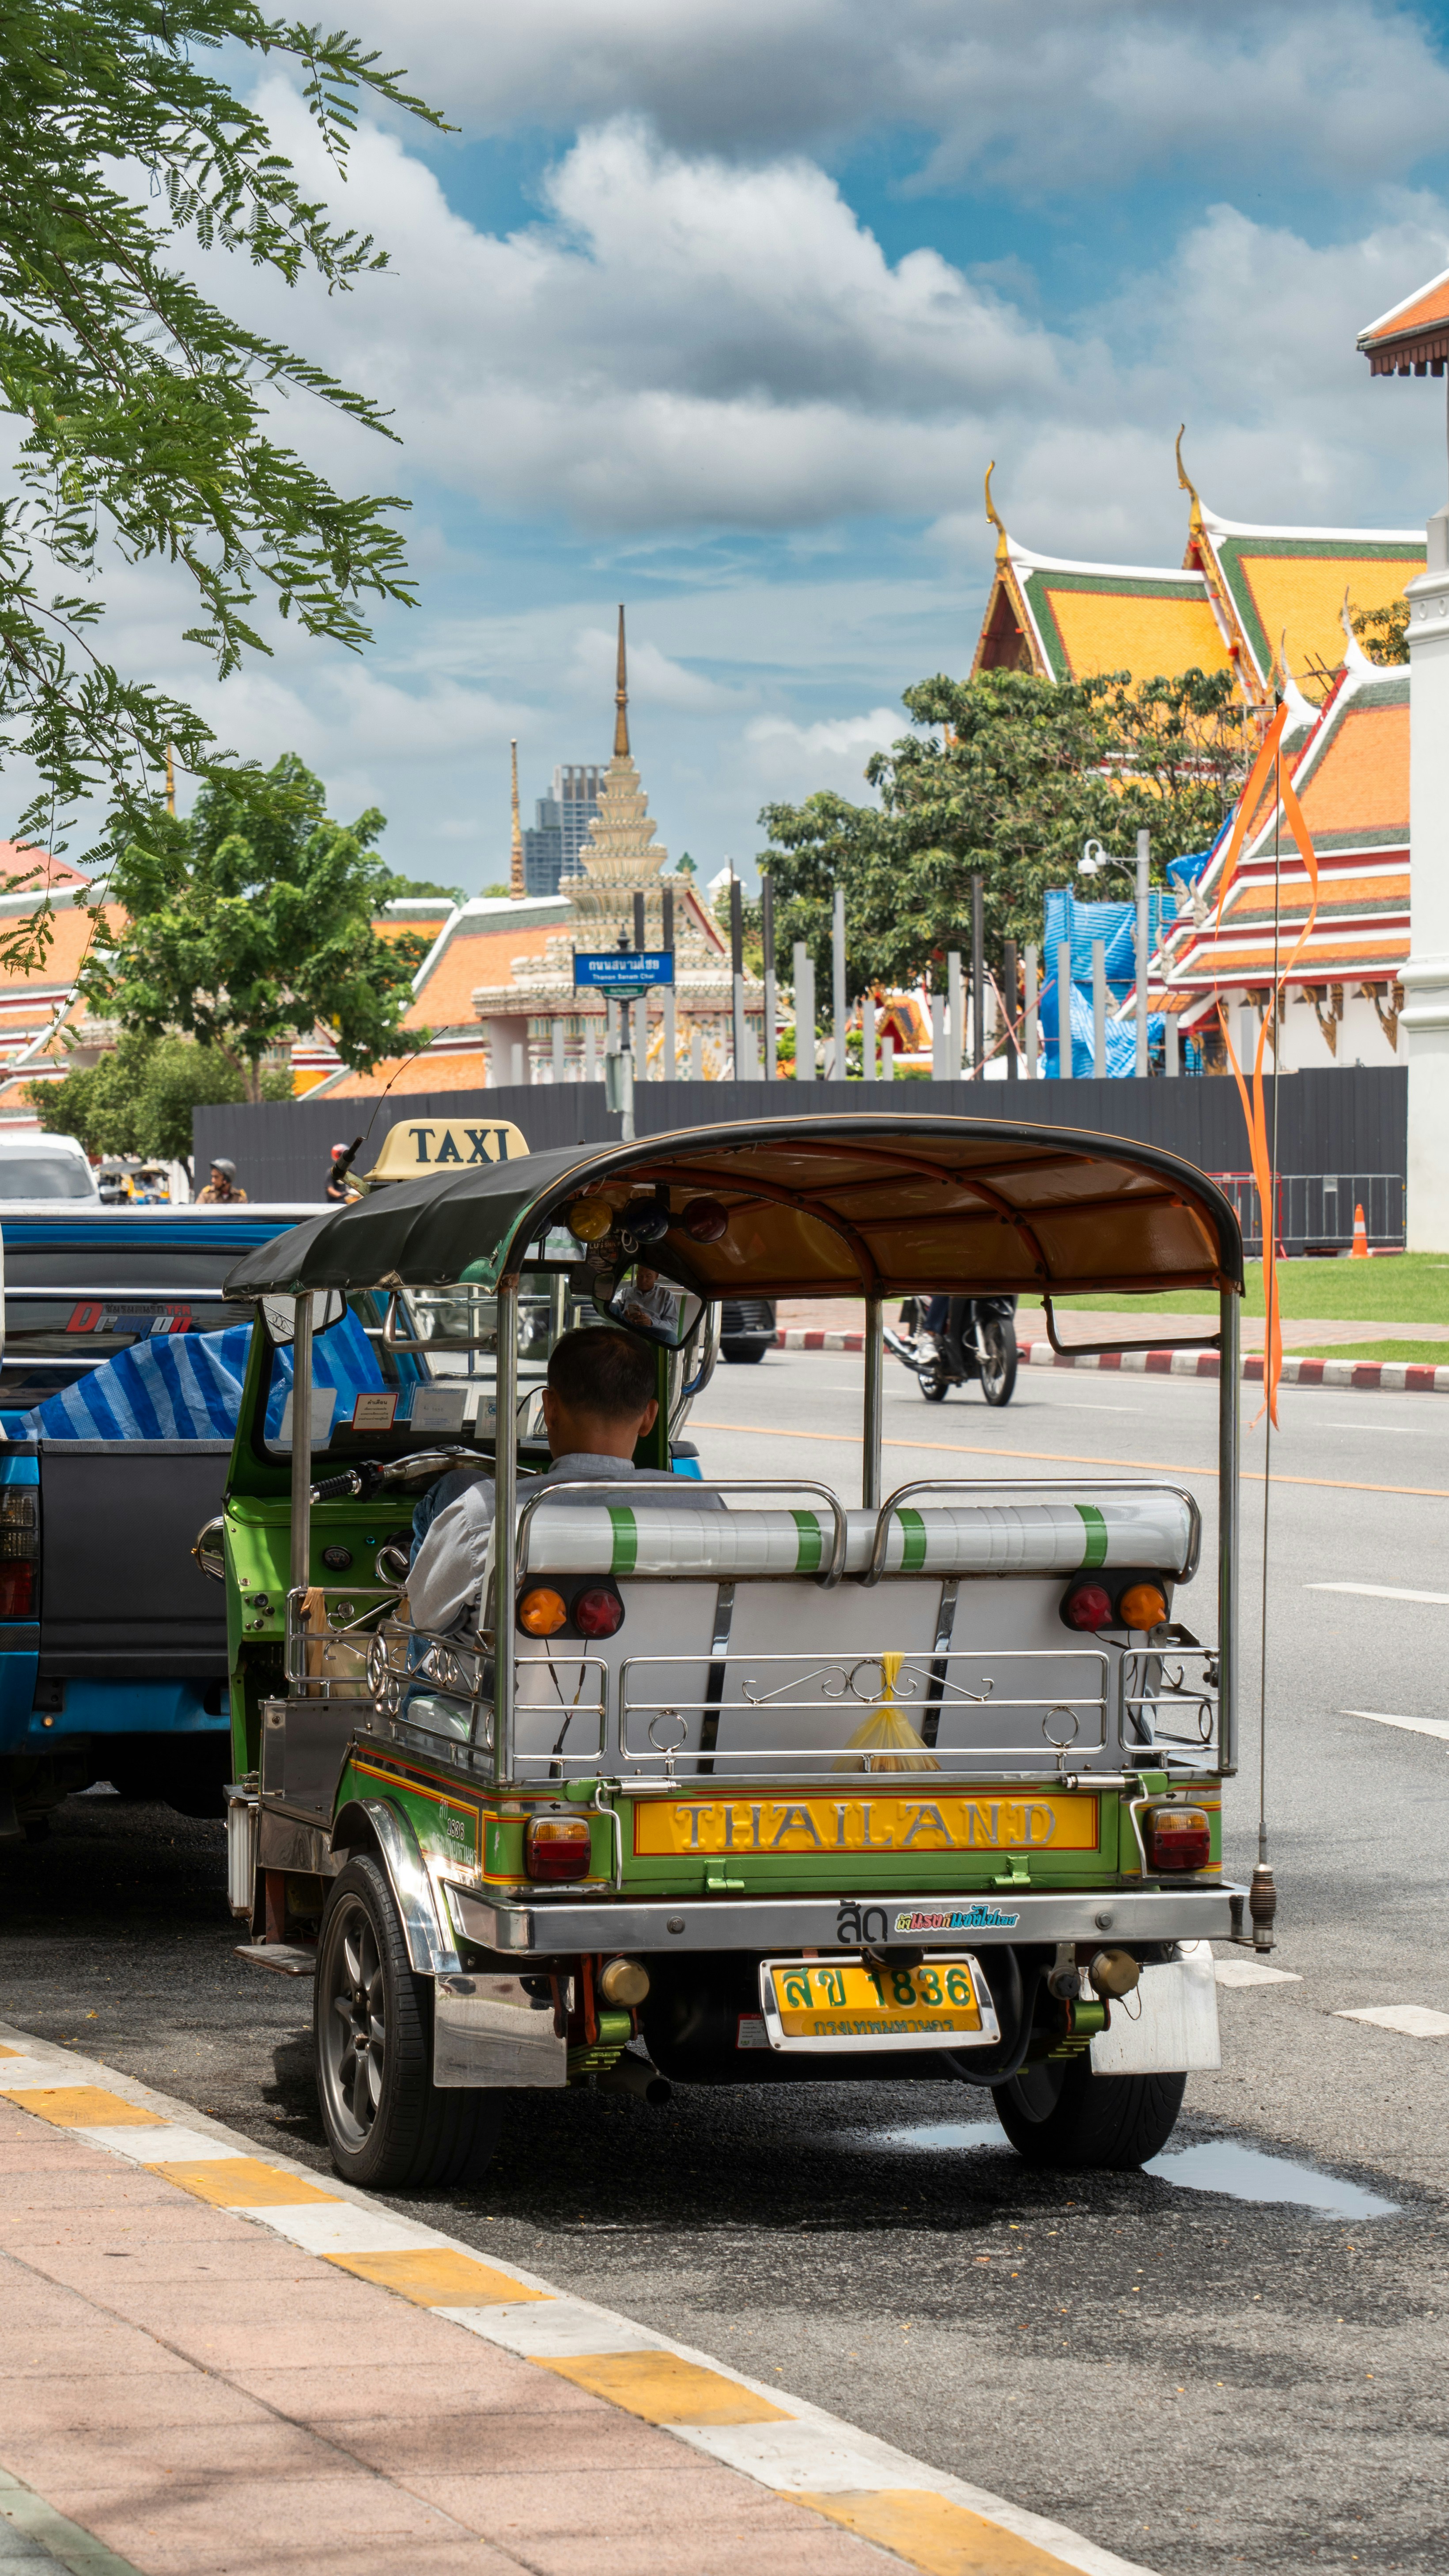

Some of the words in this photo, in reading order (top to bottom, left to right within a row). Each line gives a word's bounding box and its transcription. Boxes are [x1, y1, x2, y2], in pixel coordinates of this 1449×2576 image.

[409, 1129, 509, 1163] TAXI
[66, 1302, 193, 1341] Dragon
[165, 1305, 191, 1315] TFR
[447, 1817, 465, 1841] 1836
[674, 1801, 1056, 1849] THAILAND
[866, 1968, 971, 2007] 1836
